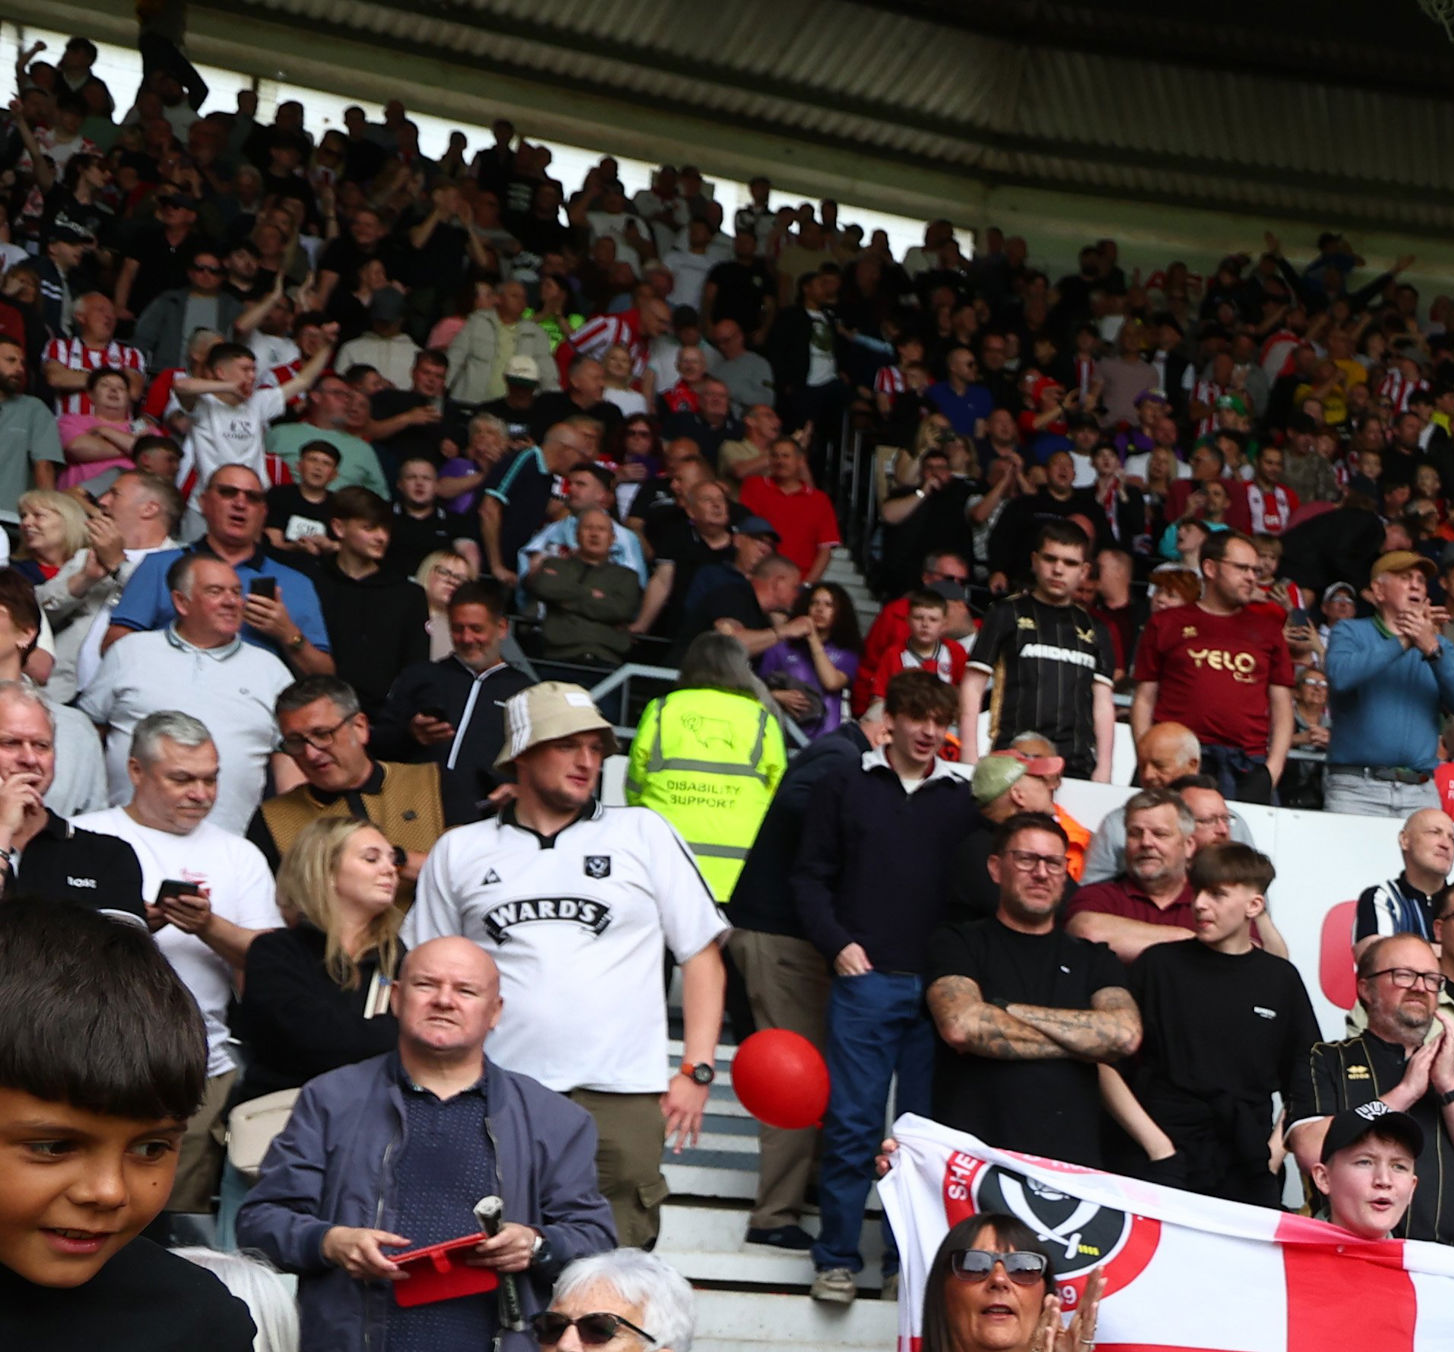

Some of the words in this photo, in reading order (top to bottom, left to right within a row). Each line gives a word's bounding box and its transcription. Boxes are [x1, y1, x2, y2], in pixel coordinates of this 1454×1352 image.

[1186, 648, 1256, 673] YELO
[666, 779, 742, 796] DISABILITY
[669, 793, 736, 809] SUPPORT
[489, 899, 600, 928] WARD'S
